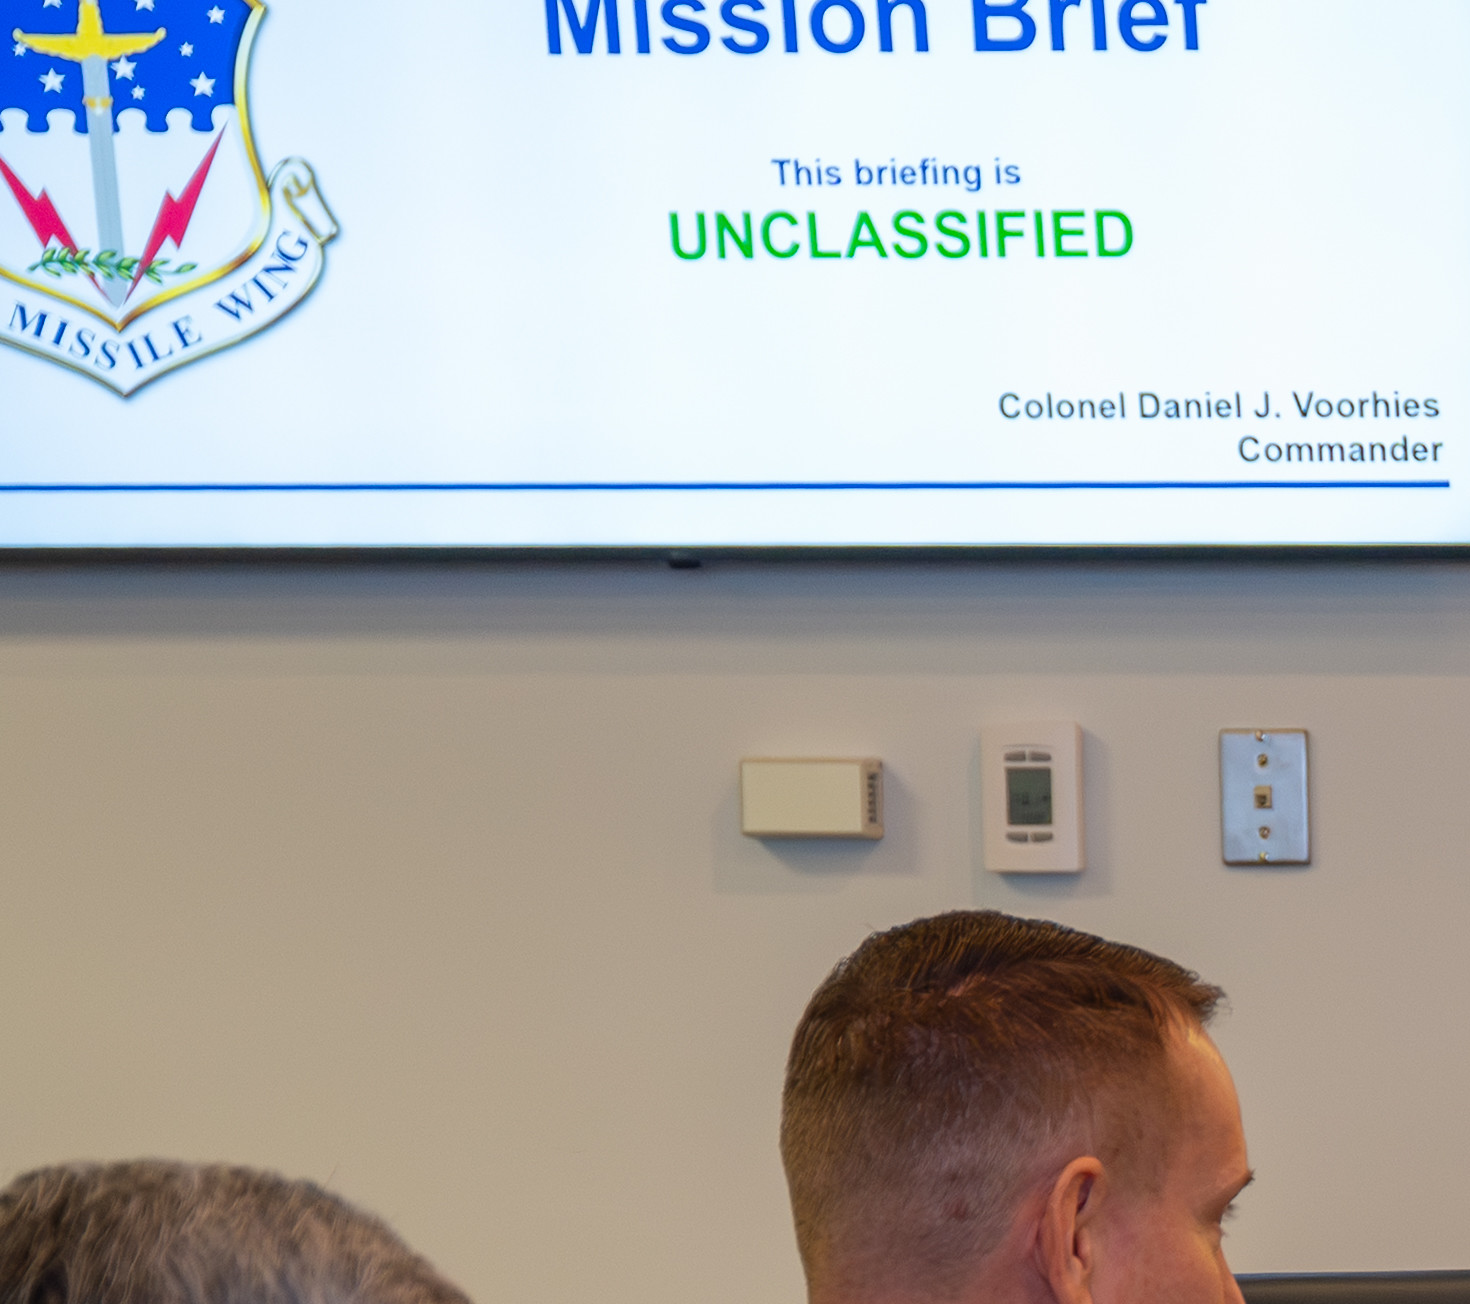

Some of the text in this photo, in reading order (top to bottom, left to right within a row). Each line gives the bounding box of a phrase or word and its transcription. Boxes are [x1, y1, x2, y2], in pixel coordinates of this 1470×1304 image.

[545, 0, 1205, 55] Mission Brief
[772, 157, 1022, 192] This briefing is
[668, 210, 1134, 261] UNCLASSIFIED
[9, 230, 310, 370] MISSILE WING
[998, 391, 1441, 419] Colonel Daniel J. Voorhies
[1238, 435, 1443, 463] Commander
